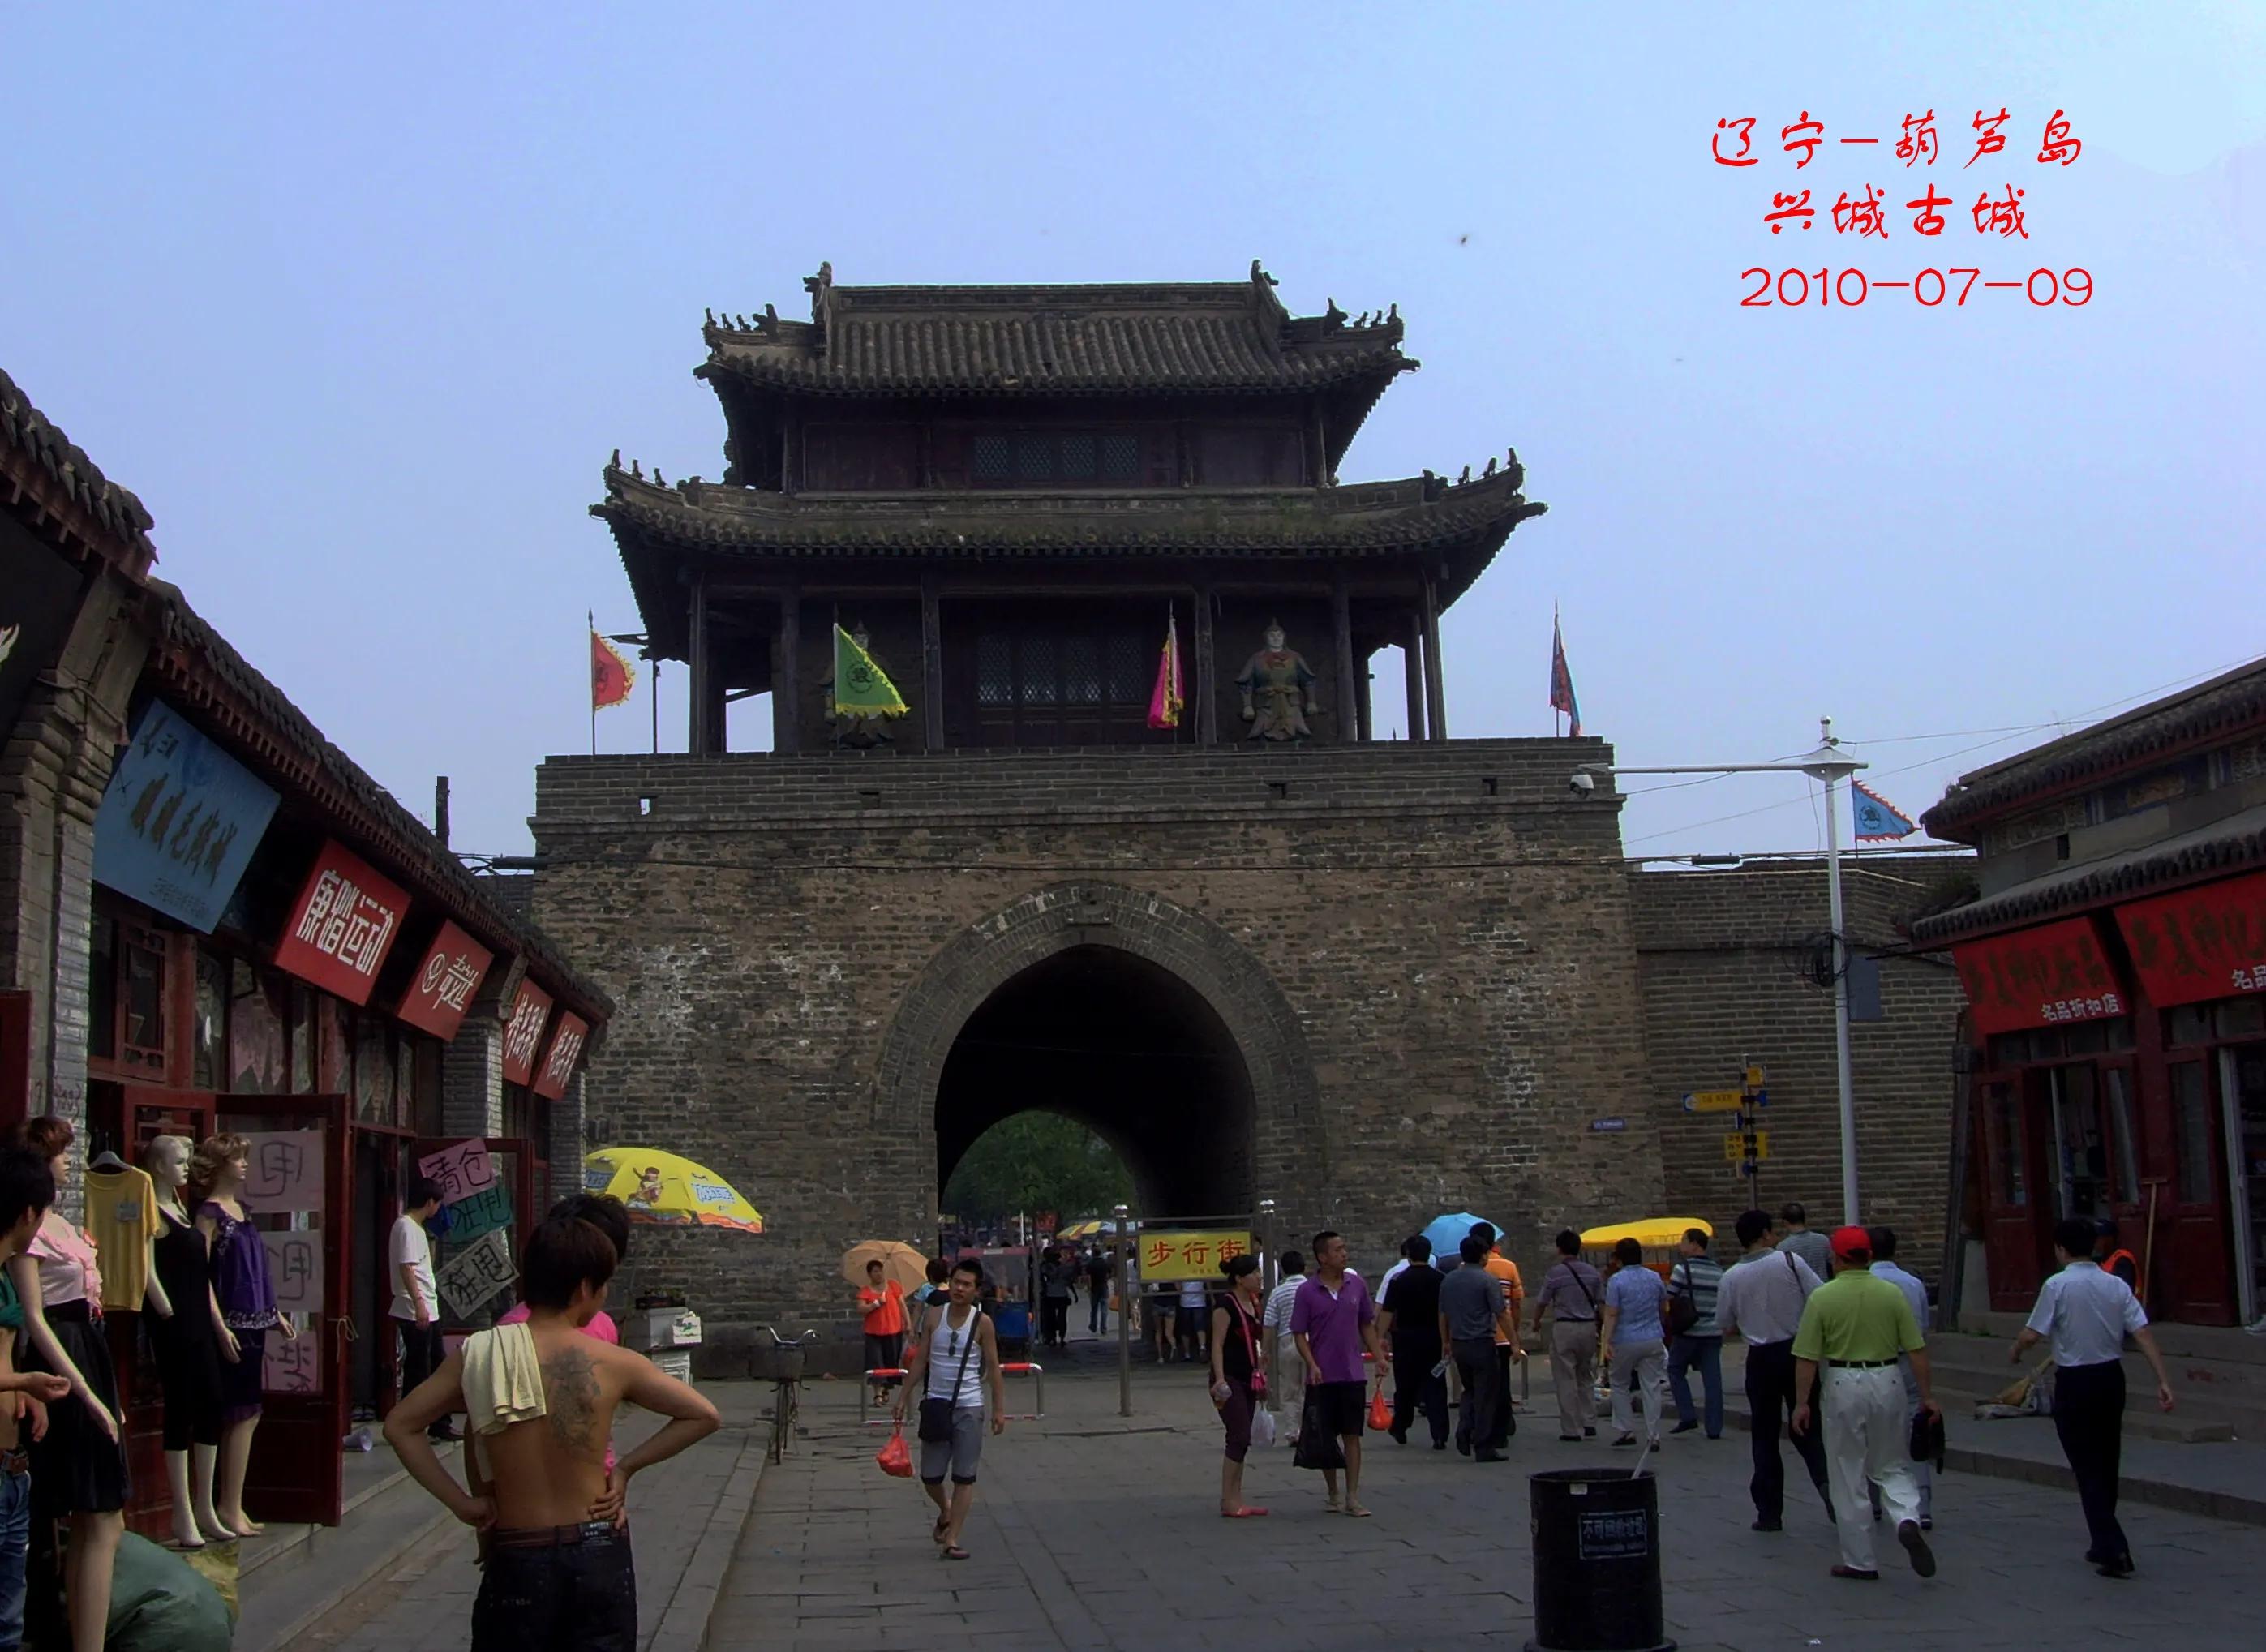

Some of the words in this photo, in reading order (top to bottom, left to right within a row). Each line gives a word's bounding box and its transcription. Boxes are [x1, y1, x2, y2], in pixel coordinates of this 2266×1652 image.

[2041, 992, 2120, 1022] 名品折扣店
[426, 1147, 492, 1194] 清仓
[1148, 1238, 1246, 1268] 步行街
[443, 1243, 515, 1305] 狂甩
